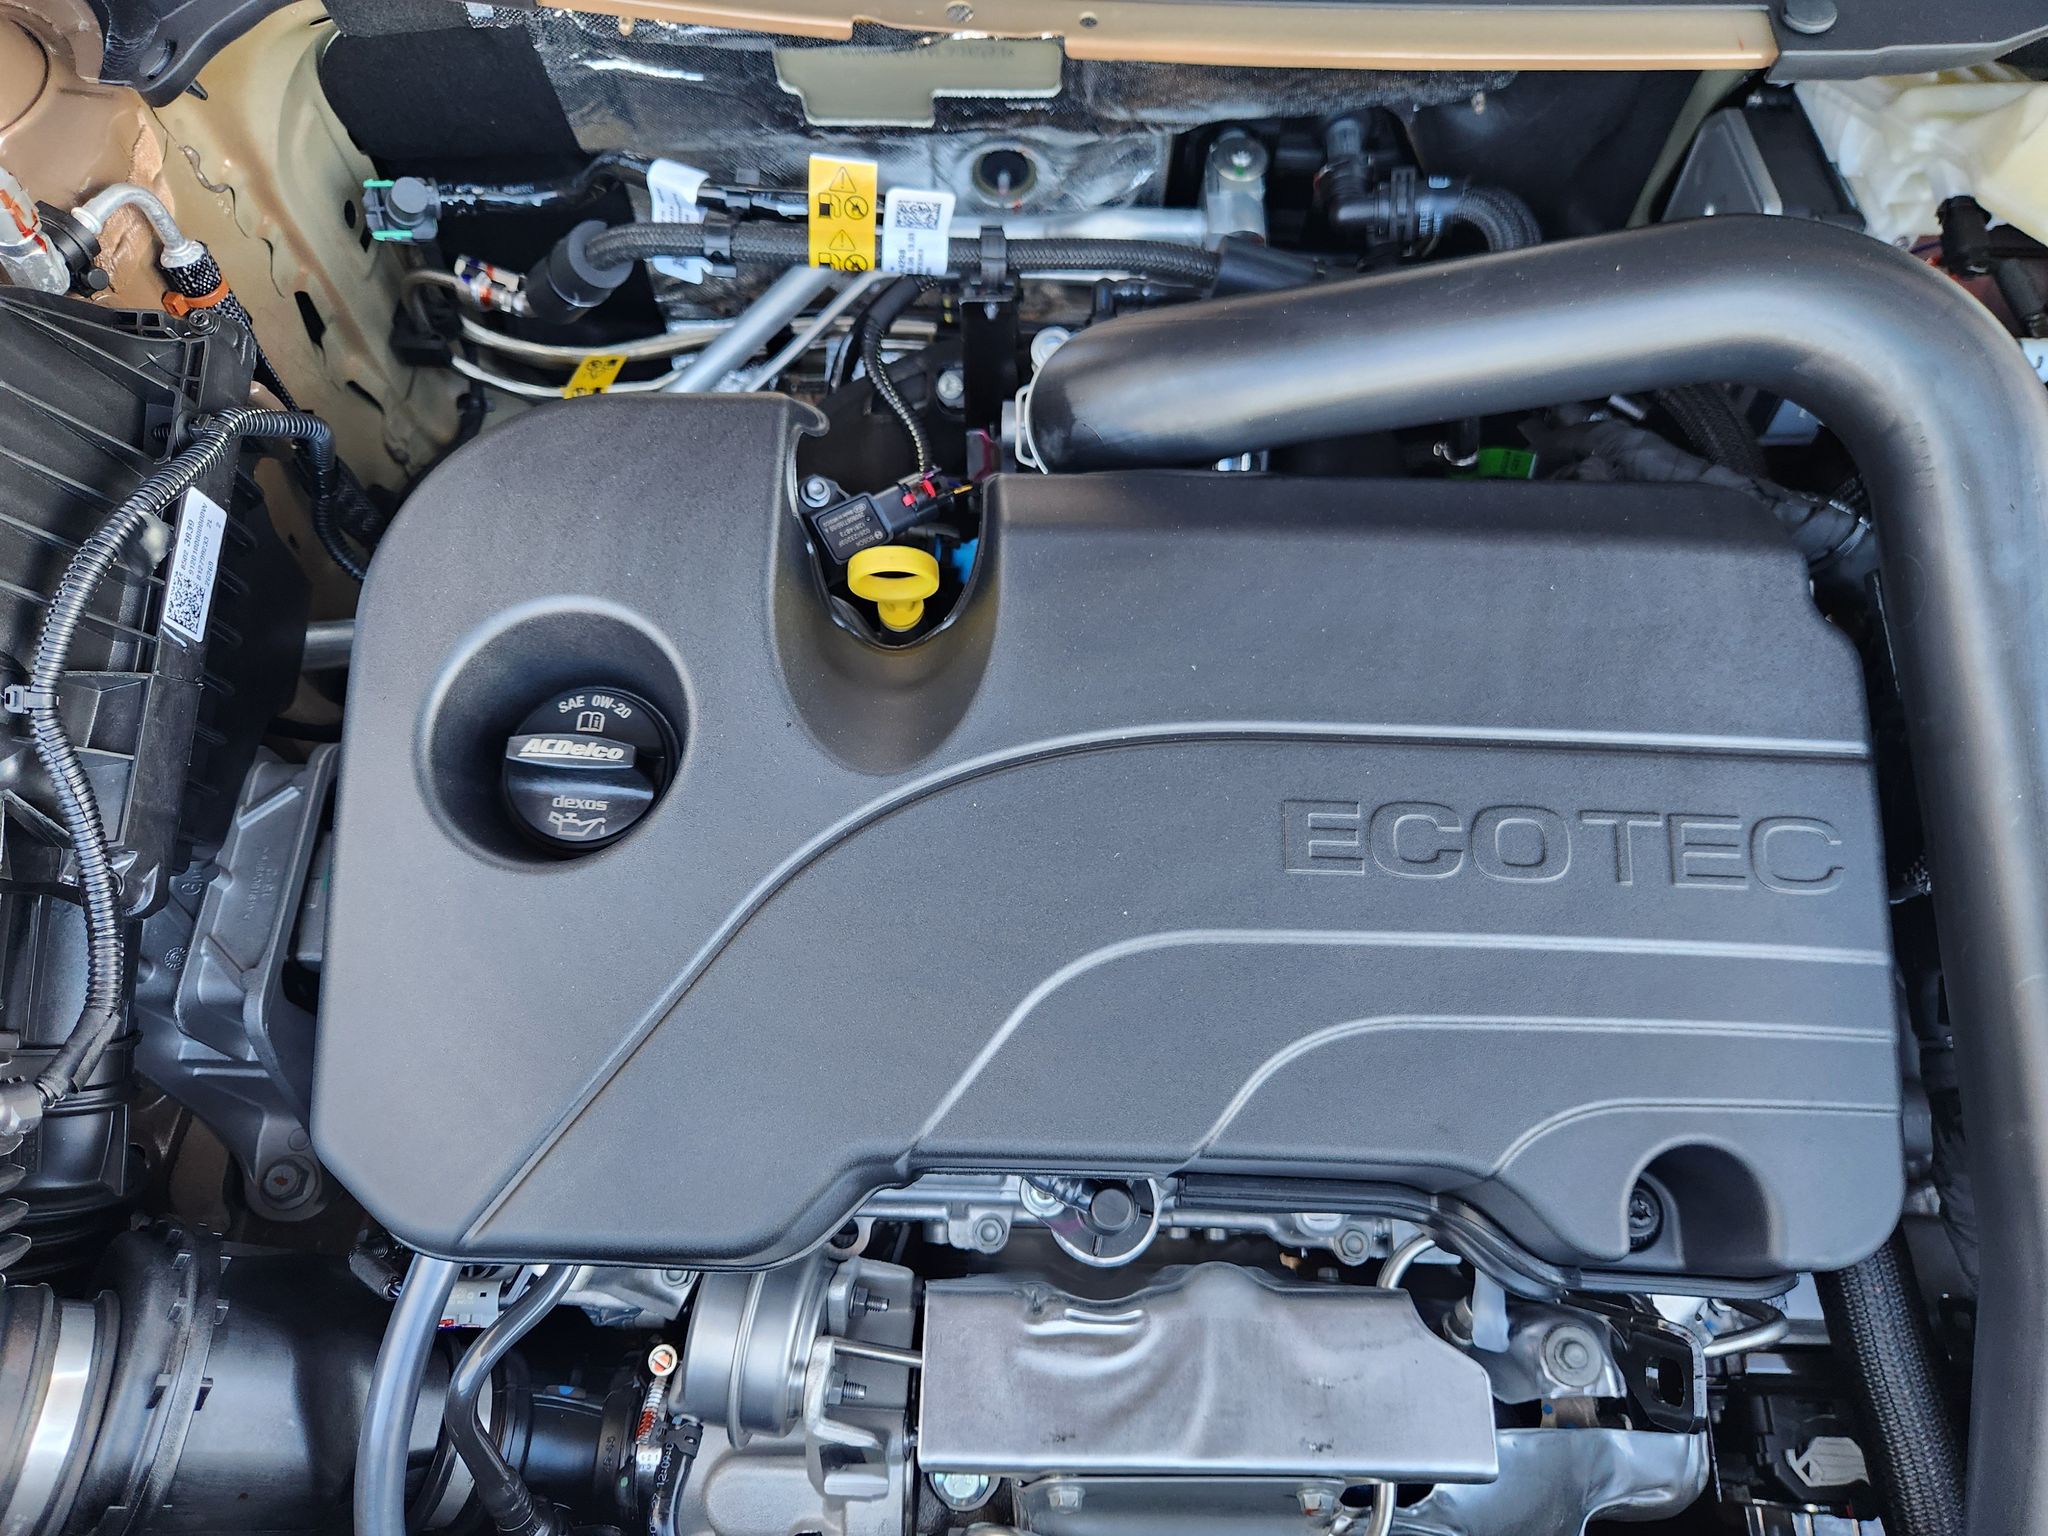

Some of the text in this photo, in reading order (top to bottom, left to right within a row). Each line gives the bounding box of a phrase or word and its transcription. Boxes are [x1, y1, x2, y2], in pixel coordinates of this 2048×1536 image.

[184, 519, 195, 547] 3839
[558, 695, 632, 719] SAE 0W-20
[520, 738, 625, 760] ACDelco
[551, 795, 611, 811] dexos
[1283, 800, 1845, 895] ECOTEC
